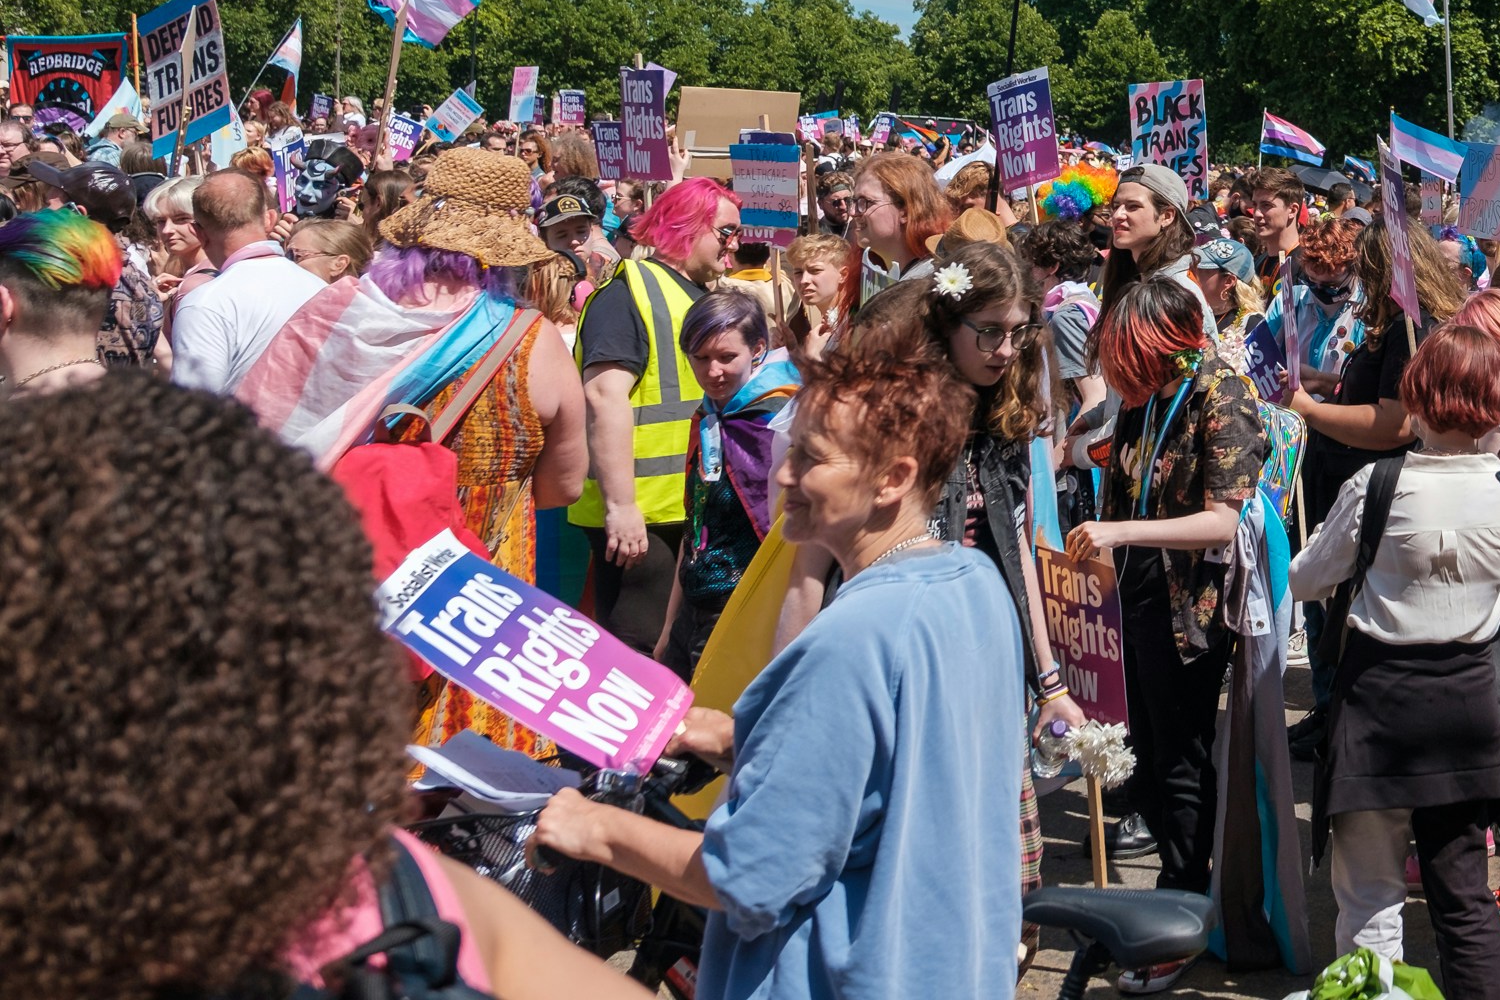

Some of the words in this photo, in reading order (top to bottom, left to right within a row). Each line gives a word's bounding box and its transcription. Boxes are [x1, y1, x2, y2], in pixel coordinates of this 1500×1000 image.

[29, 53, 104, 77] REDBRIDGE
[620, 71, 654, 104] Trans
[997, 79, 1017, 93] Socialist
[1016, 74, 1038, 87] Worker
[561, 95, 580, 103] Trans
[562, 102, 583, 114] Rights
[991, 90, 1037, 122] Trans
[1135, 93, 1204, 128] BLACK
[562, 112, 577, 121] Now
[624, 106, 665, 146] Rights
[388, 129, 415, 150] ights
[593, 123, 620, 141] Trans
[997, 114, 1052, 152] Rights
[1136, 126, 1201, 158] TRANS
[597, 142, 623, 164] Right
[626, 141, 651, 174] Now
[748, 147, 780, 162] TRANS
[1002, 151, 1036, 180] Now
[600, 161, 620, 179] Now
[734, 167, 788, 183] HEALTHCARE
[751, 184, 776, 198] SAVES
[1427, 196, 1434, 210] IS
[746, 202, 773, 215] LIVES
[385, 562, 438, 609] Socialist
[1036, 548, 1103, 608] Trans
[396, 572, 524, 667] Trans
[1046, 598, 1119, 662] Rights
[473, 606, 600, 714] Rights
[548, 667, 655, 757] Now
